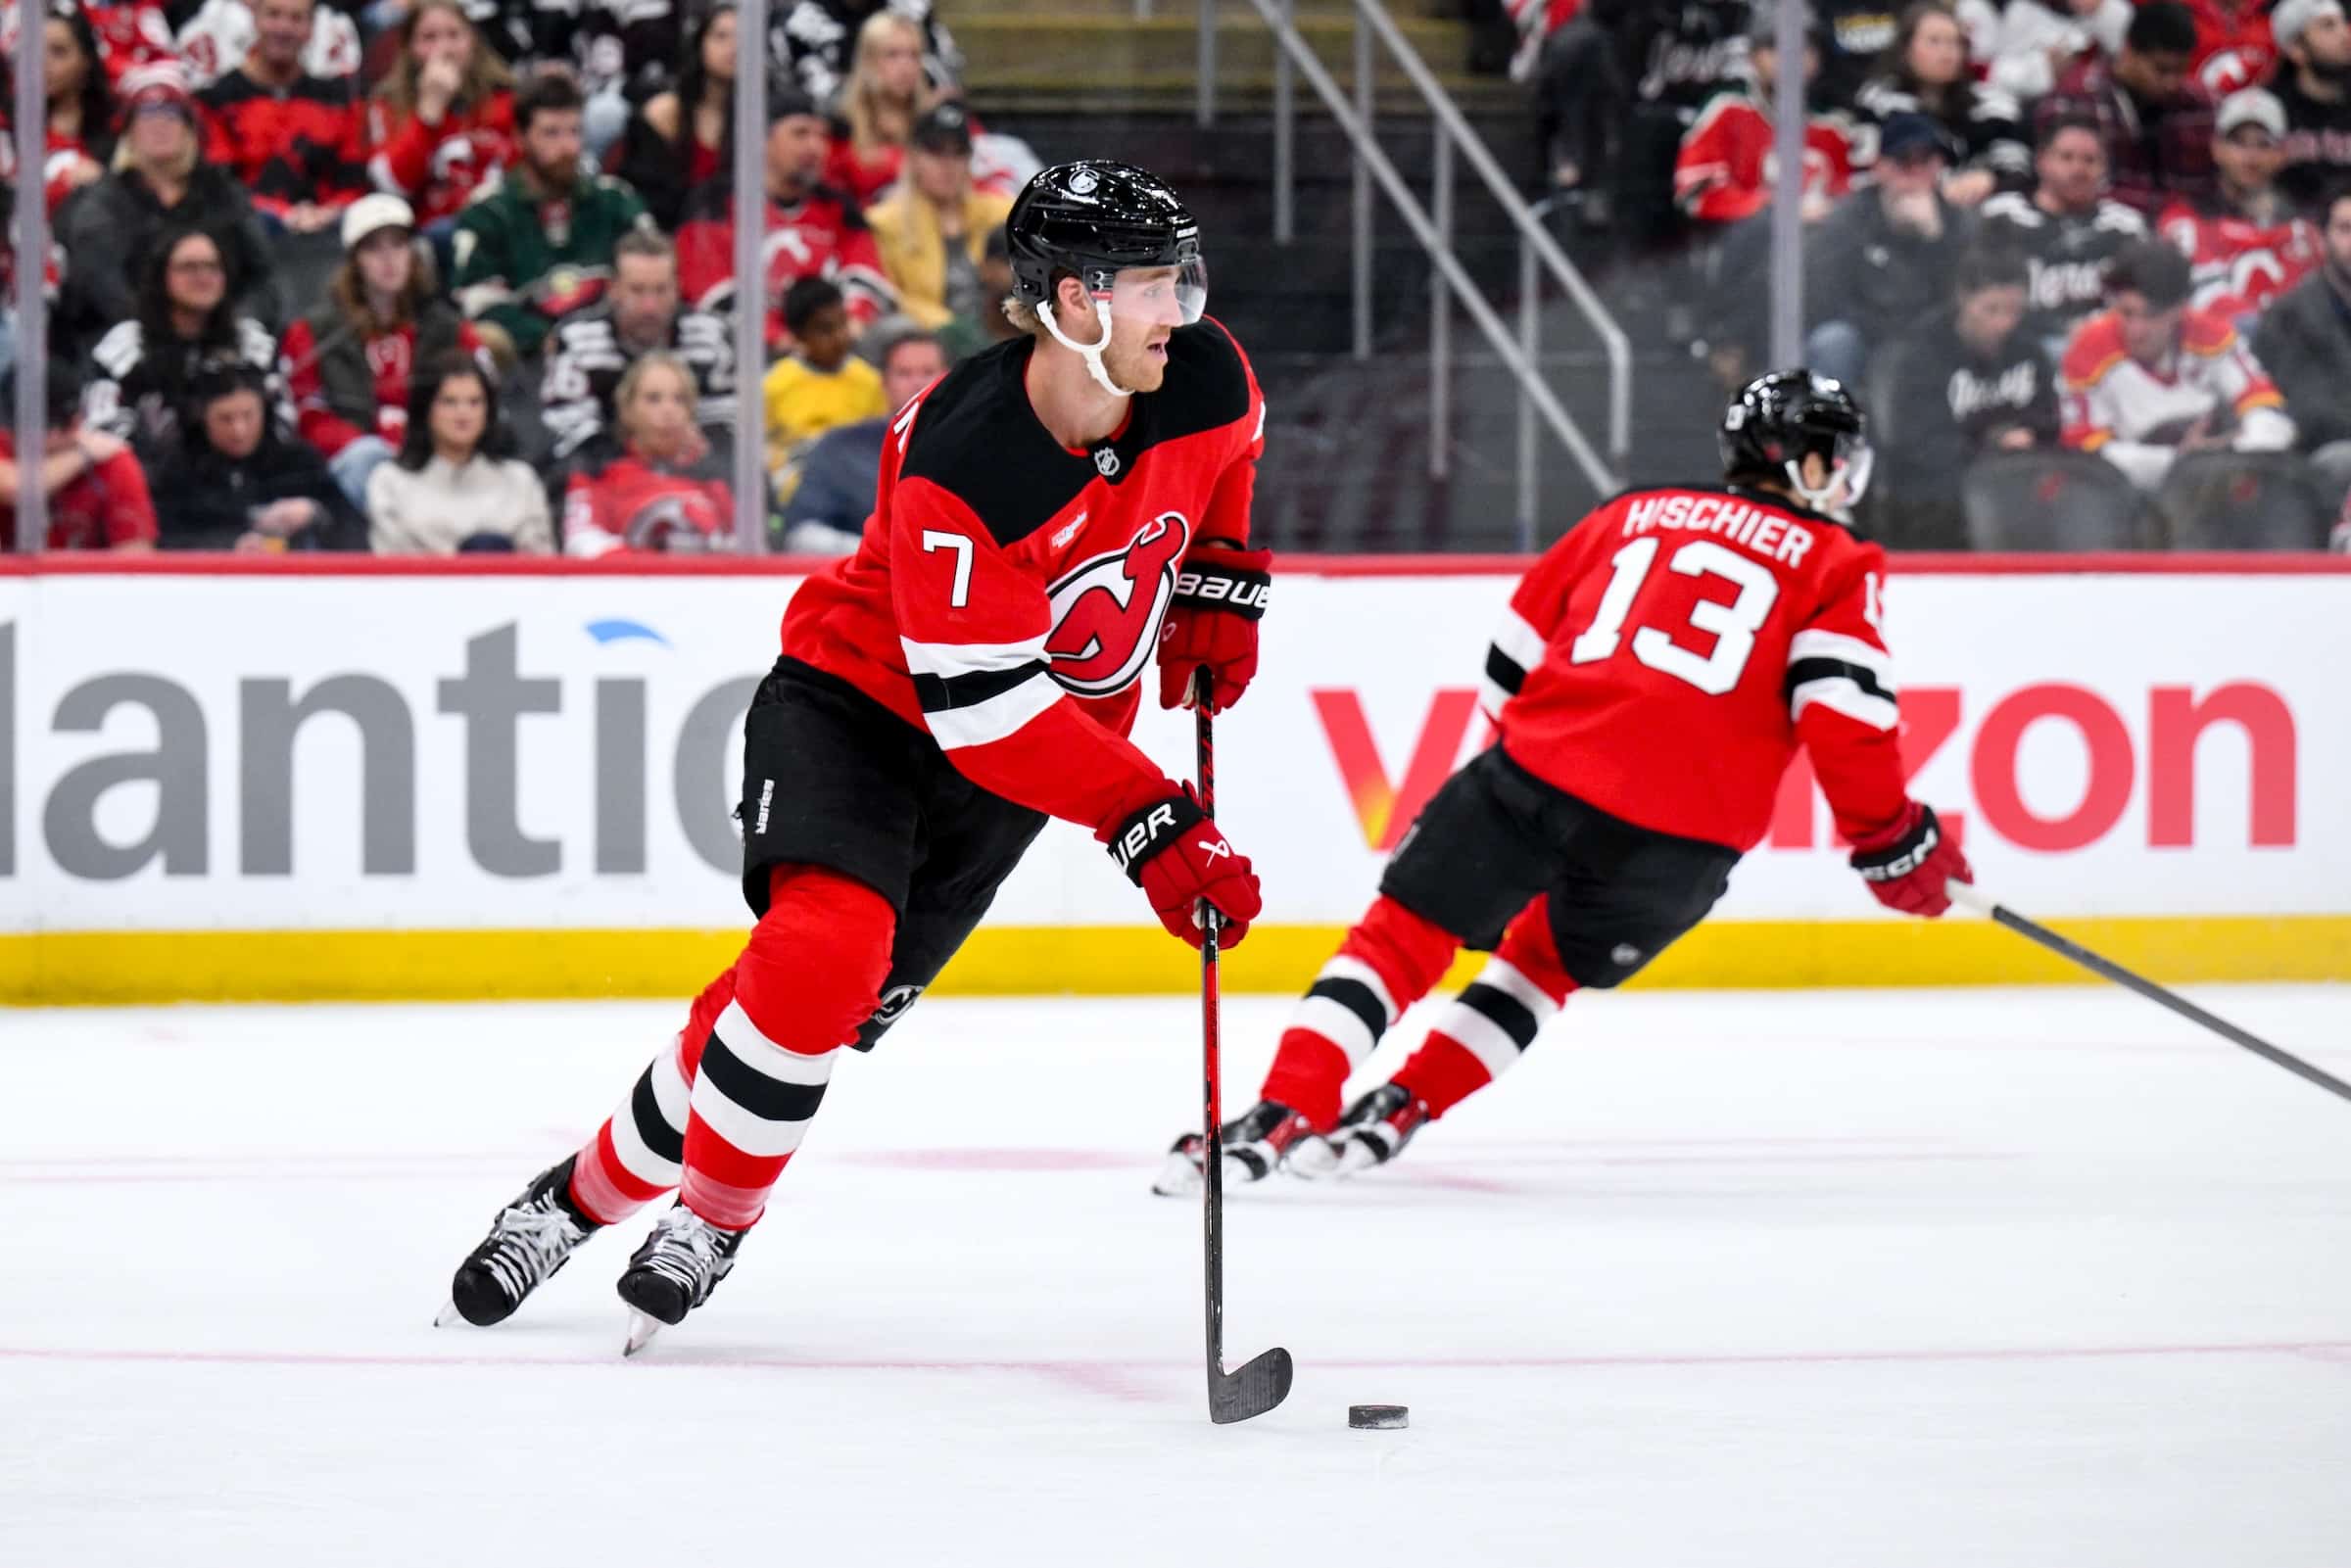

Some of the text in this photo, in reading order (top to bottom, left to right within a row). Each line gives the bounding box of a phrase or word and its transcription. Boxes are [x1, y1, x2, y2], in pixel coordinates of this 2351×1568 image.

[922, 528, 975, 607] 7
[1622, 496, 1813, 569] HISCHIER
[1570, 536, 1780, 696] 13
